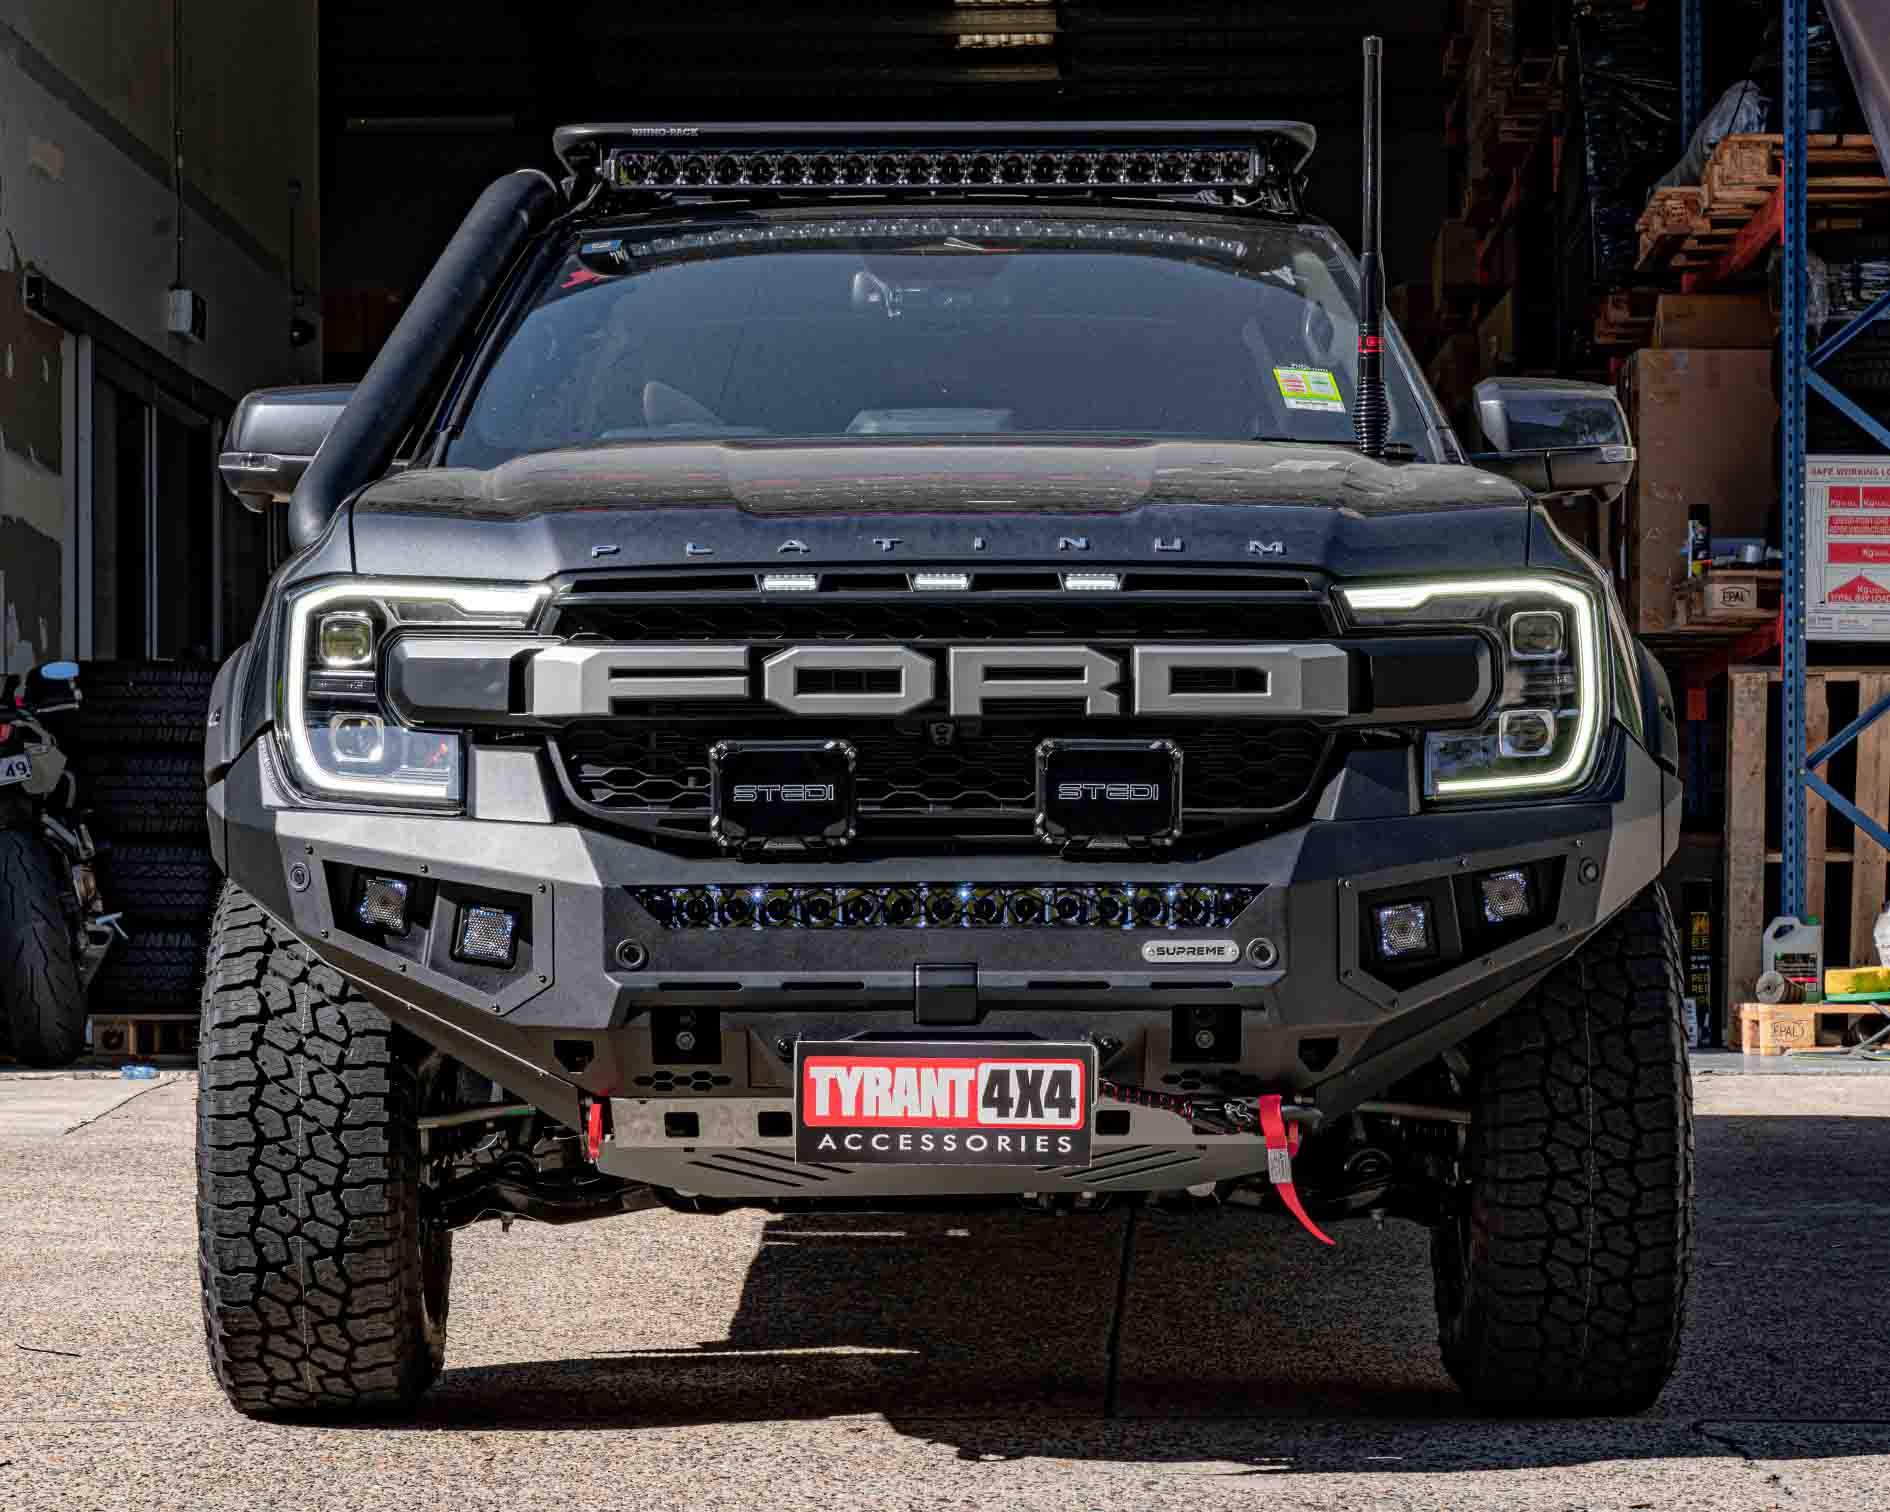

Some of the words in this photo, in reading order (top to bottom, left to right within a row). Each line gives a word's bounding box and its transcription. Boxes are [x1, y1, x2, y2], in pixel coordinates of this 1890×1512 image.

[631, 127, 699, 137] RHINO-RACK
[592, 537, 1287, 557] PLATINUM
[530, 643, 1349, 717] FORD
[733, 784, 834, 801] STEDI
[1058, 783, 1159, 801] STEDI
[1156, 946, 1225, 956] SUPREME
[809, 1066, 976, 1119] TYRANT
[981, 1068, 1077, 1120] 4X4
[818, 1133, 1073, 1153] ACCESSORIES
